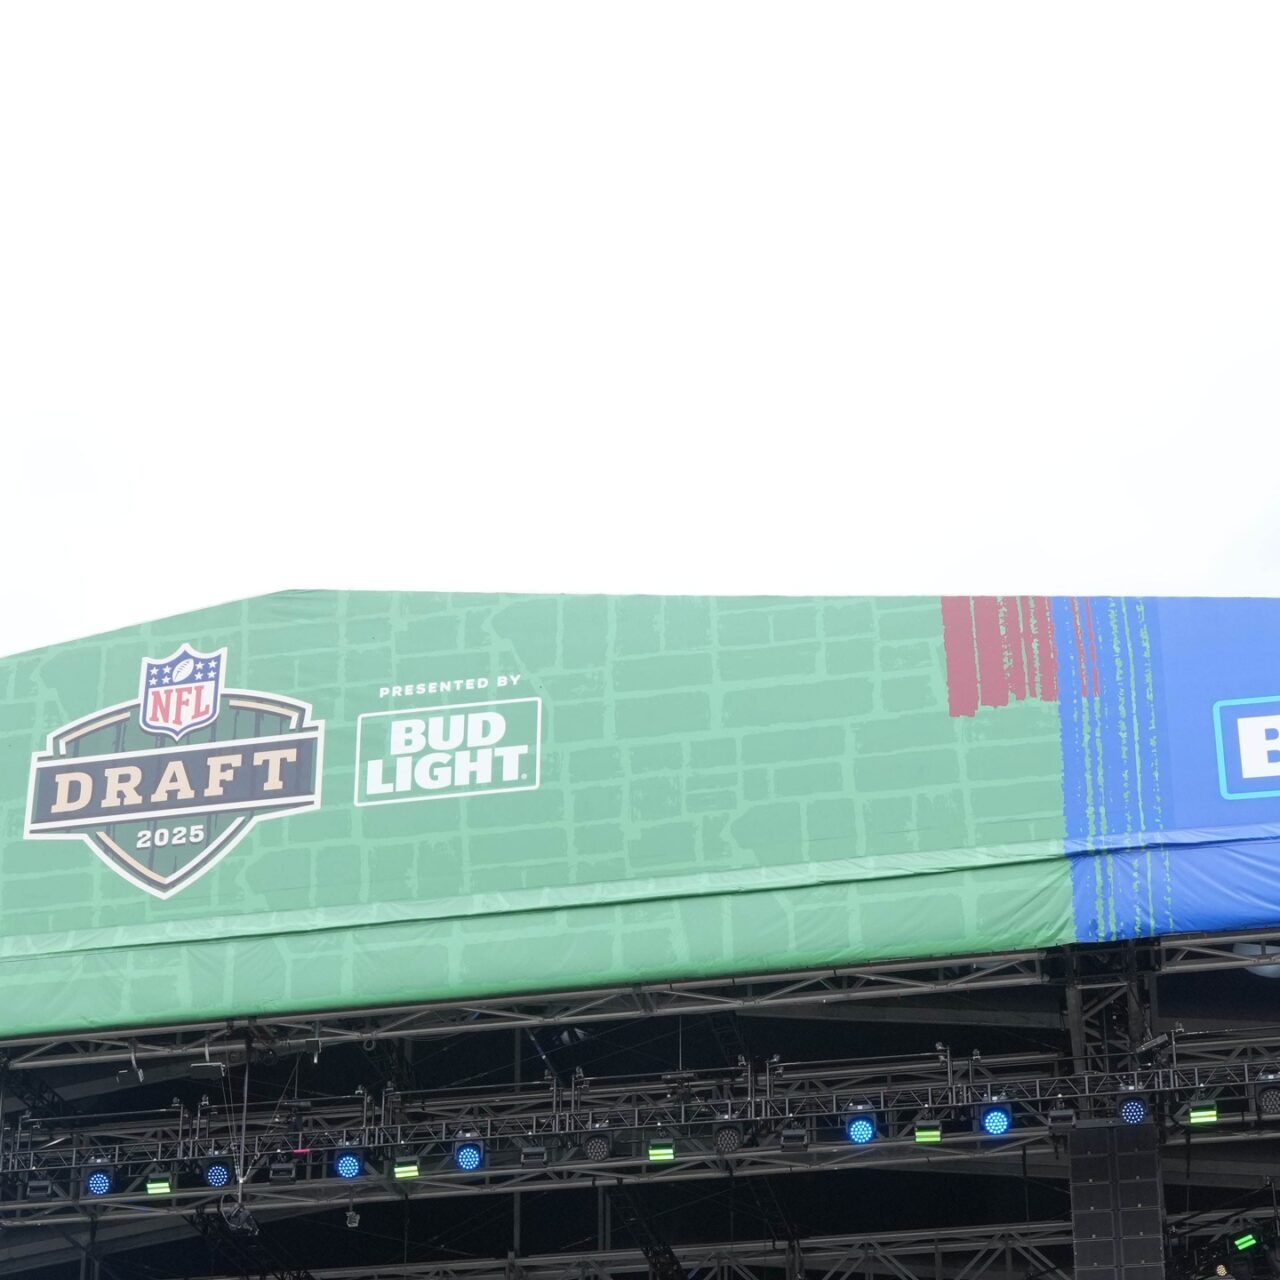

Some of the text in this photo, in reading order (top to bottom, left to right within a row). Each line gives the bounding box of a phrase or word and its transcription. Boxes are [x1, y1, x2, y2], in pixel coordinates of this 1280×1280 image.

[150, 683, 210, 725] NFL
[379, 674, 521, 698] PRESENTED BY
[390, 712, 506, 755] BUD
[50, 747, 297, 814] DRAFT
[366, 745, 528, 795] LIGHT
[136, 824, 205, 849] 2025
